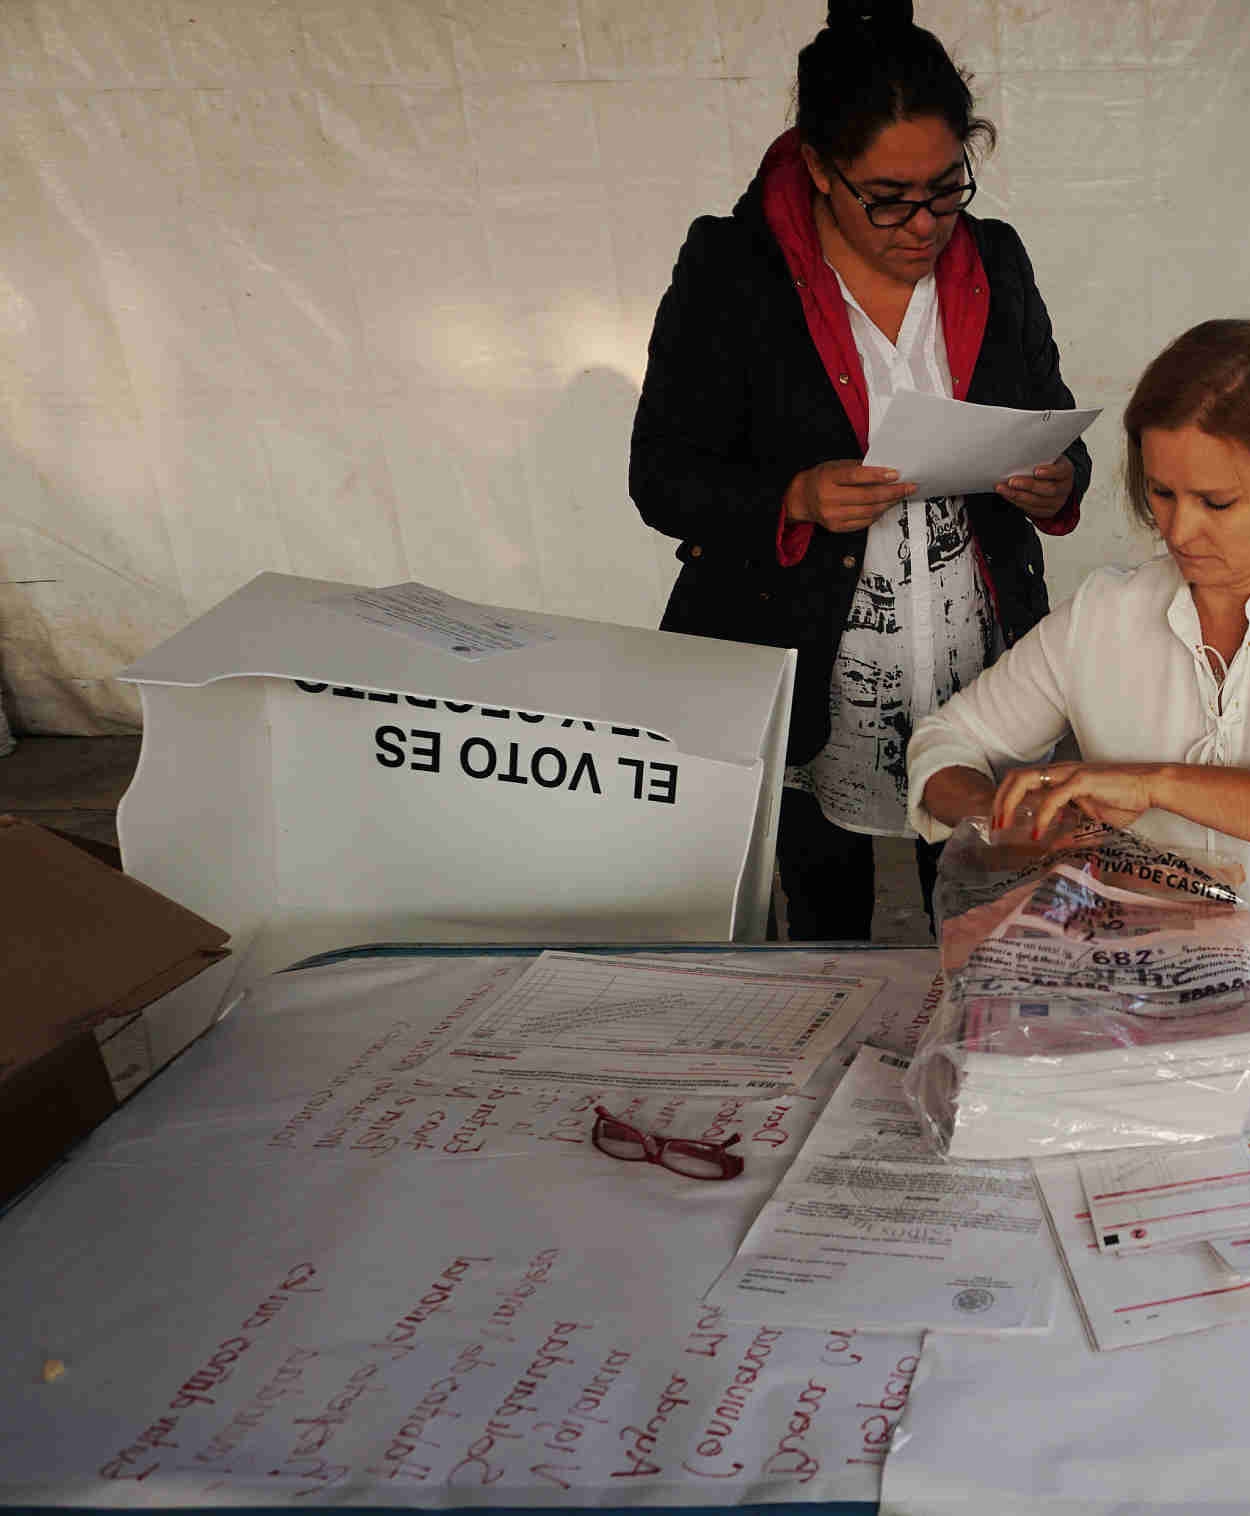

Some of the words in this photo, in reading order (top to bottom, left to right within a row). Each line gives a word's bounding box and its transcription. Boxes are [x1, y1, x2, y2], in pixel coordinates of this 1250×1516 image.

[374, 725, 441, 774] ES
[459, 736, 602, 795] VOTO
[617, 757, 679, 805] EL
[1100, 857, 1134, 875] TIVA
[1138, 866, 1162, 884] DE
[1165, 873, 1241, 905] CASIL
